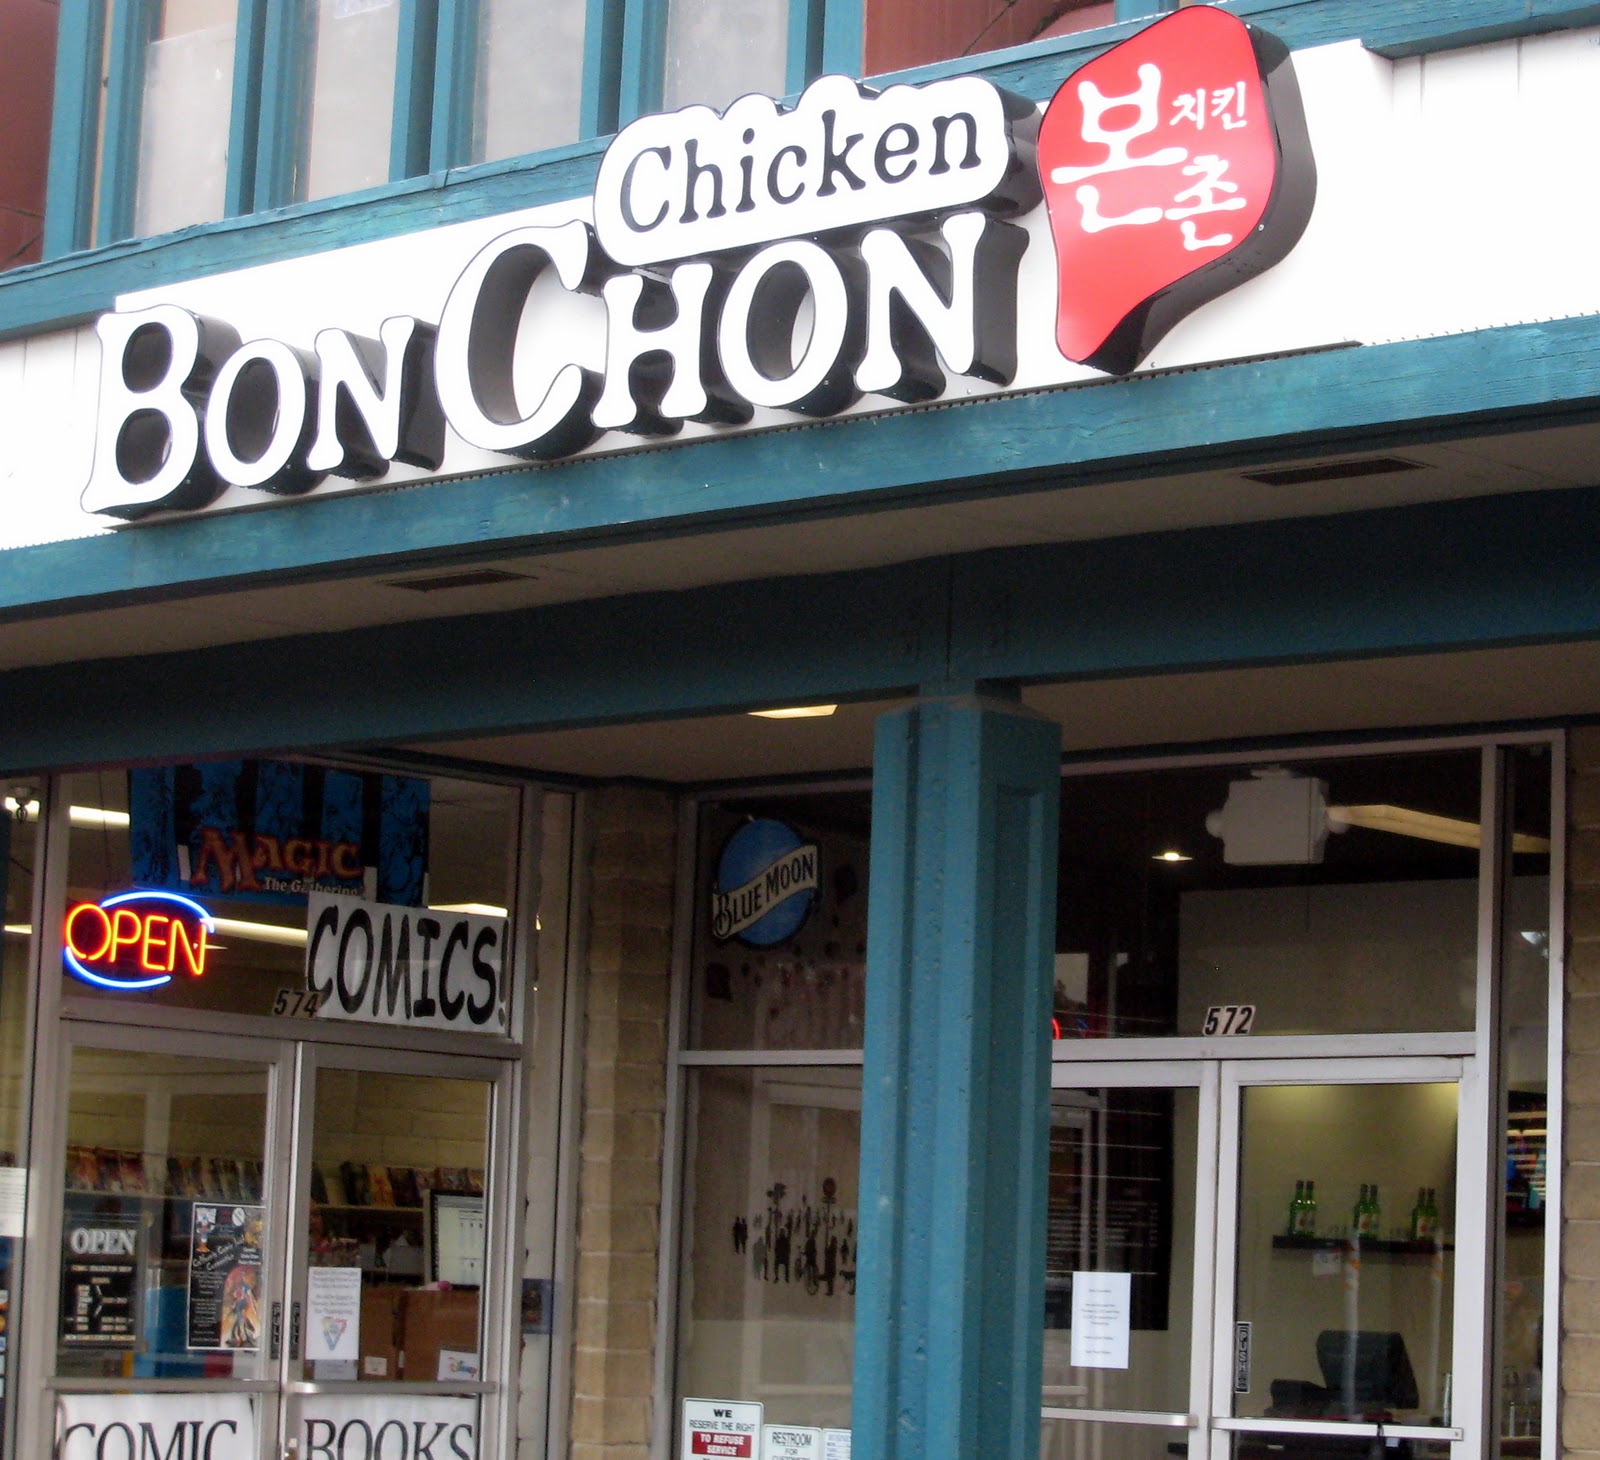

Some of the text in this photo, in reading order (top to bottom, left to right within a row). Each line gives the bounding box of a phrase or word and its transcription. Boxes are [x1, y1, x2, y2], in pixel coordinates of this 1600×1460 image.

[1169, 80, 1248, 131] 치킨
[619, 108, 981, 233] Chicken
[263, 876, 287, 891] The
[766, 853, 814, 903] MOON
[65, 902, 207, 976] OPEN
[272, 989, 318, 1018] 574
[1205, 1006, 1255, 1036] 572
[71, 1227, 137, 1256] OPEN
[689, 1419, 755, 1432] RESERVE THE RIGHT
[713, 1409, 733, 1418] WE
[64, 1418, 238, 1460] COMIC
[303, 1418, 473, 1460] BOOKS
[700, 1433, 744, 1445] TO REFUSE
[707, 1444, 737, 1455] SERVICE
[772, 1431, 812, 1446] RESTROOM
